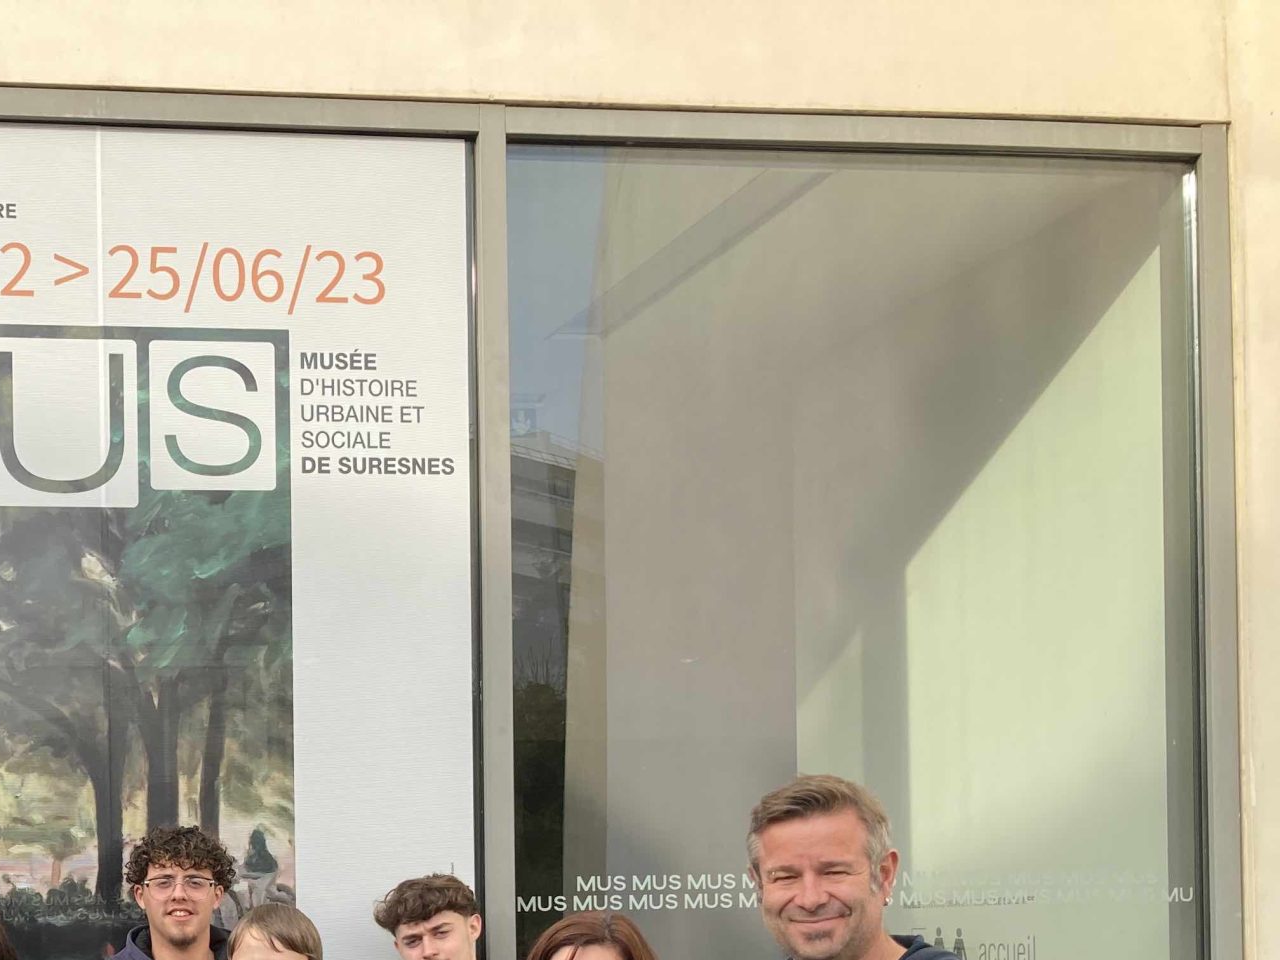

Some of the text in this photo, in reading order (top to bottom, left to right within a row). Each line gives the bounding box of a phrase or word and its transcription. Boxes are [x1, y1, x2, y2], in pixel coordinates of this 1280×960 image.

[108, 242, 386, 315] 25/06/23
[300, 349, 377, 371] MUSÉE
[300, 378, 418, 398] D'HISTOIRE
[301, 404, 425, 423] URBAINE ET
[301, 430, 391, 449] SOCIALE
[301, 456, 455, 476] DE SURESNES
[576, 875, 626, 892] MUS
[632, 874, 682, 891] MUS
[687, 873, 737, 890] MUS
[516, 896, 567, 912] MUS
[573, 894, 623, 911] MUS
[629, 894, 678, 911] MUS
[684, 892, 733, 909] MUS
